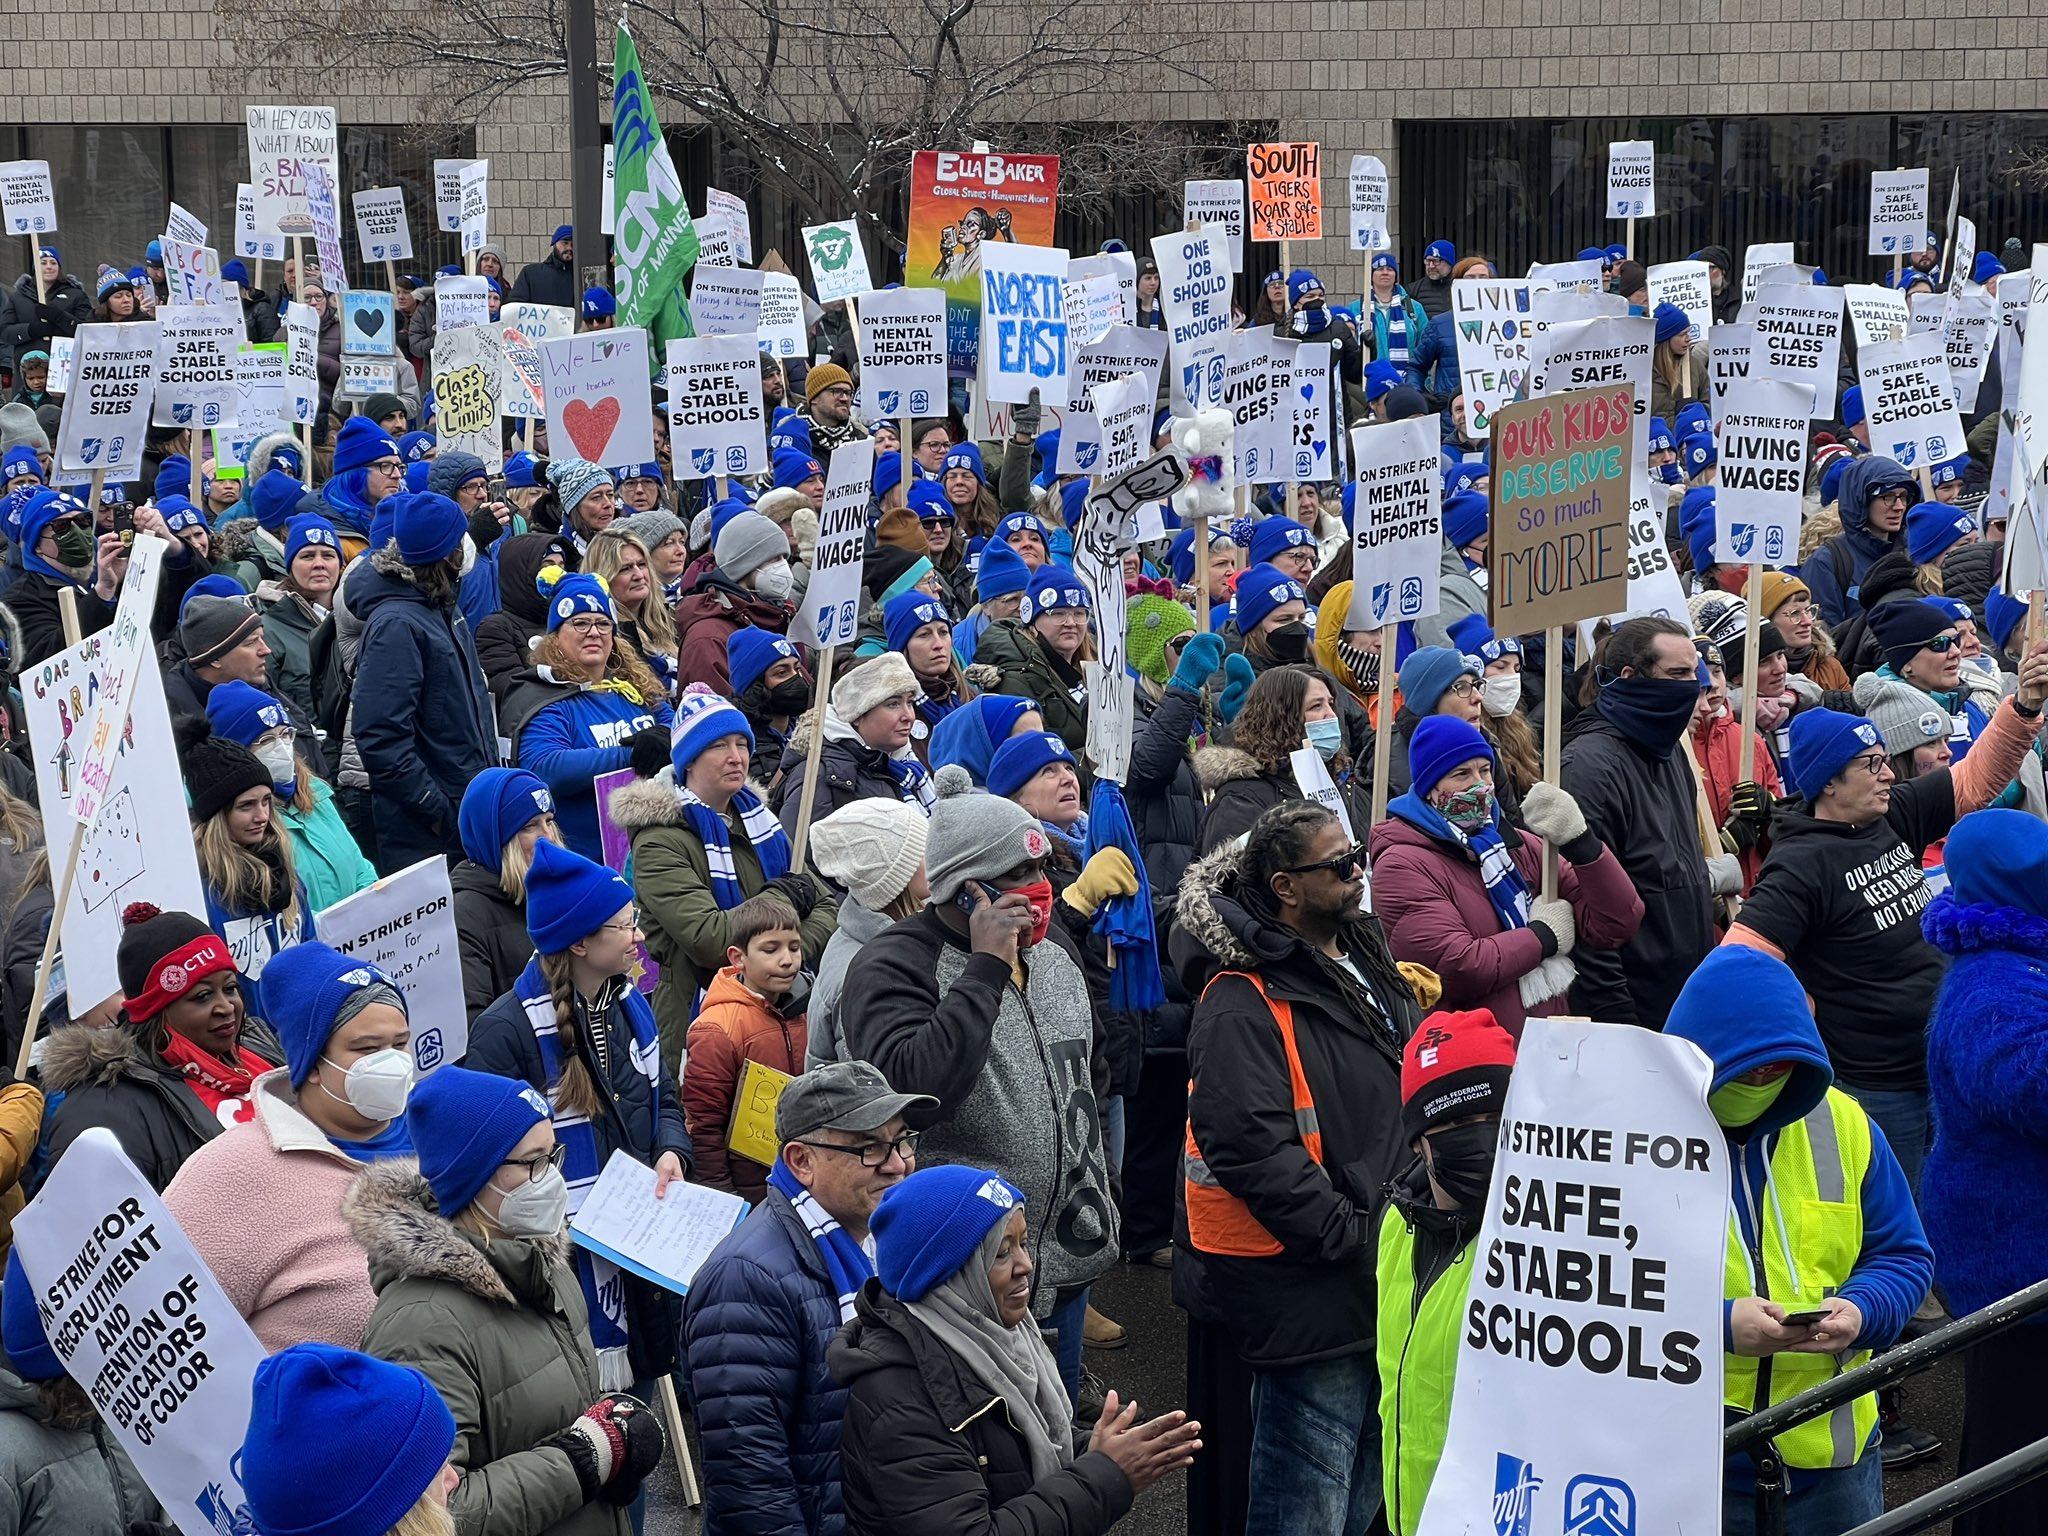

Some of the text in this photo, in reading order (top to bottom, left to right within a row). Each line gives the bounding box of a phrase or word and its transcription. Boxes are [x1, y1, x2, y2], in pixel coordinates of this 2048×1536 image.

[249, 108, 332, 130] OH HEY GUYS
[254, 135, 336, 155] WHAT ABOUT
[936, 152, 1045, 186] ELLA BAKER
[1250, 144, 1320, 179] SOUTH
[1612, 165, 1650, 176] LIVING
[7, 181, 43, 191] MENTAL
[932, 185, 961, 197] GLOBAL
[1262, 180, 1310, 199] TIGERS
[1355, 184, 1383, 193] MENTAL
[1610, 177, 1651, 188] WAGES
[4, 195, 50, 206] SUPPORTS
[9, 188, 43, 198] HEALTH
[1356, 194, 1382, 203] HEALTH
[1885, 194, 1914, 203] SAFE,
[357, 207, 403, 220] SMALLER
[461, 206, 486, 223] SCHOOLS
[1189, 210, 1240, 222] LIVING
[1252, 200, 1318, 225] ROAR Safe
[1351, 203, 1386, 213] SUPPORTS
[1879, 203, 1918, 213] STABLE
[366, 217, 398, 227] CLASS
[1873, 212, 1924, 223] SCHOOLS
[369, 225, 397, 235] SIZES
[1275, 219, 1316, 237] Stable
[1182, 239, 1210, 261] ONE
[1186, 260, 1212, 281] JOB
[452, 293, 472, 301] STRIKE
[696, 283, 759, 296] ON STRIKE FOR
[1173, 275, 1226, 304] SHOULD
[1658, 291, 1702, 304] STABLE
[1662, 282, 1696, 295] SAFE,
[518, 306, 550, 320] PAY
[1192, 300, 1210, 318] BE
[1759, 306, 1839, 320] ON STRIKE FOR
[1853, 310, 1909, 323] SMALLER
[863, 315, 942, 325] ON STRIKE FOR
[1174, 313, 1230, 344] ENOUGH!
[1756, 319, 1837, 338] SMALLER
[162, 327, 234, 338] ON STRIKE FOR
[516, 323, 547, 338] AND
[873, 328, 933, 340] MENTAL
[176, 341, 220, 354] SAFE,
[874, 341, 932, 353] HEALTH
[997, 320, 1069, 379] EAST
[1493, 344, 1530, 362] FOR
[1768, 336, 1823, 353] CLASS
[85, 349, 153, 361] ON STRIKE FOR
[169, 355, 226, 369] STABLE
[545, 341, 584, 377] We
[863, 354, 943, 367] SUPPORTS
[1078, 355, 1159, 368] ON STRIKE FOR
[1554, 344, 1649, 364] ON STRIKE FOR
[1769, 353, 1819, 369] SIZES
[81, 364, 150, 380] SMALLER
[671, 360, 756, 375] ON STRIKE FOR
[1272, 359, 1291, 369] FOR
[1307, 368, 1325, 378] FOR
[1570, 363, 1627, 383] SAFE,
[1864, 355, 1943, 378] ON STRIKE FOR
[160, 369, 234, 383] SCHOOLS
[435, 369, 480, 401] Class
[688, 376, 740, 392] SAFE,
[1882, 371, 1930, 391] SAFE,
[90, 383, 139, 398] CLASS
[1877, 385, 1940, 408] STABLE
[89, 400, 132, 415] SIZES
[450, 389, 480, 414] size
[681, 392, 749, 409] STABLE
[444, 400, 492, 432] Limits
[672, 407, 760, 426] SCHOOLS
[1871, 398, 1953, 425] SCHOOLS
[1502, 391, 1632, 462] OUR KIDS
[1725, 414, 1805, 431] ON STRIKE FOR
[1724, 435, 1801, 462] LIVING
[1360, 456, 1438, 483] ON STRIKE FOR
[1501, 445, 1623, 505] DESERVE
[1720, 465, 1801, 492] WAGES
[1368, 478, 1430, 505] MENTAL
[1370, 498, 1428, 526] HEALTH
[1517, 507, 1546, 533] So
[1554, 489, 1602, 528] much
[1357, 517, 1439, 550] SUPPORTS
[1500, 522, 1624, 609] MORE
[1845, 862, 1876, 893] OUR
[1862, 875, 1900, 908] NEED
[1872, 900, 1904, 932] NOT
[333, 896, 448, 956] ON STRIKE FOR
[405, 932, 422, 949] For
[183, 946, 216, 972] CTU
[1423, 1082, 1490, 1113] SAINT PAUL FEDERATION
[1431, 1098, 1463, 1115] EDUCATORS
[1463, 1092, 1484, 1102] LOCAL
[1500, 1117, 1711, 1173] ON STRIKE FOR
[1501, 1173, 1640, 1252] SAFE,
[39, 1196, 146, 1331] ON STRIKE FOR
[1484, 1236, 1667, 1314] STABLE
[53, 1223, 163, 1364] RECRUITMENT
[94, 1302, 132, 1357] AND
[90, 1273, 200, 1412] RETENTION OF
[1466, 1298, 1704, 1386] SCHOOLS
[111, 1313, 208, 1431] EDUCATORS
[133, 1349, 216, 1447] OF COLOR
